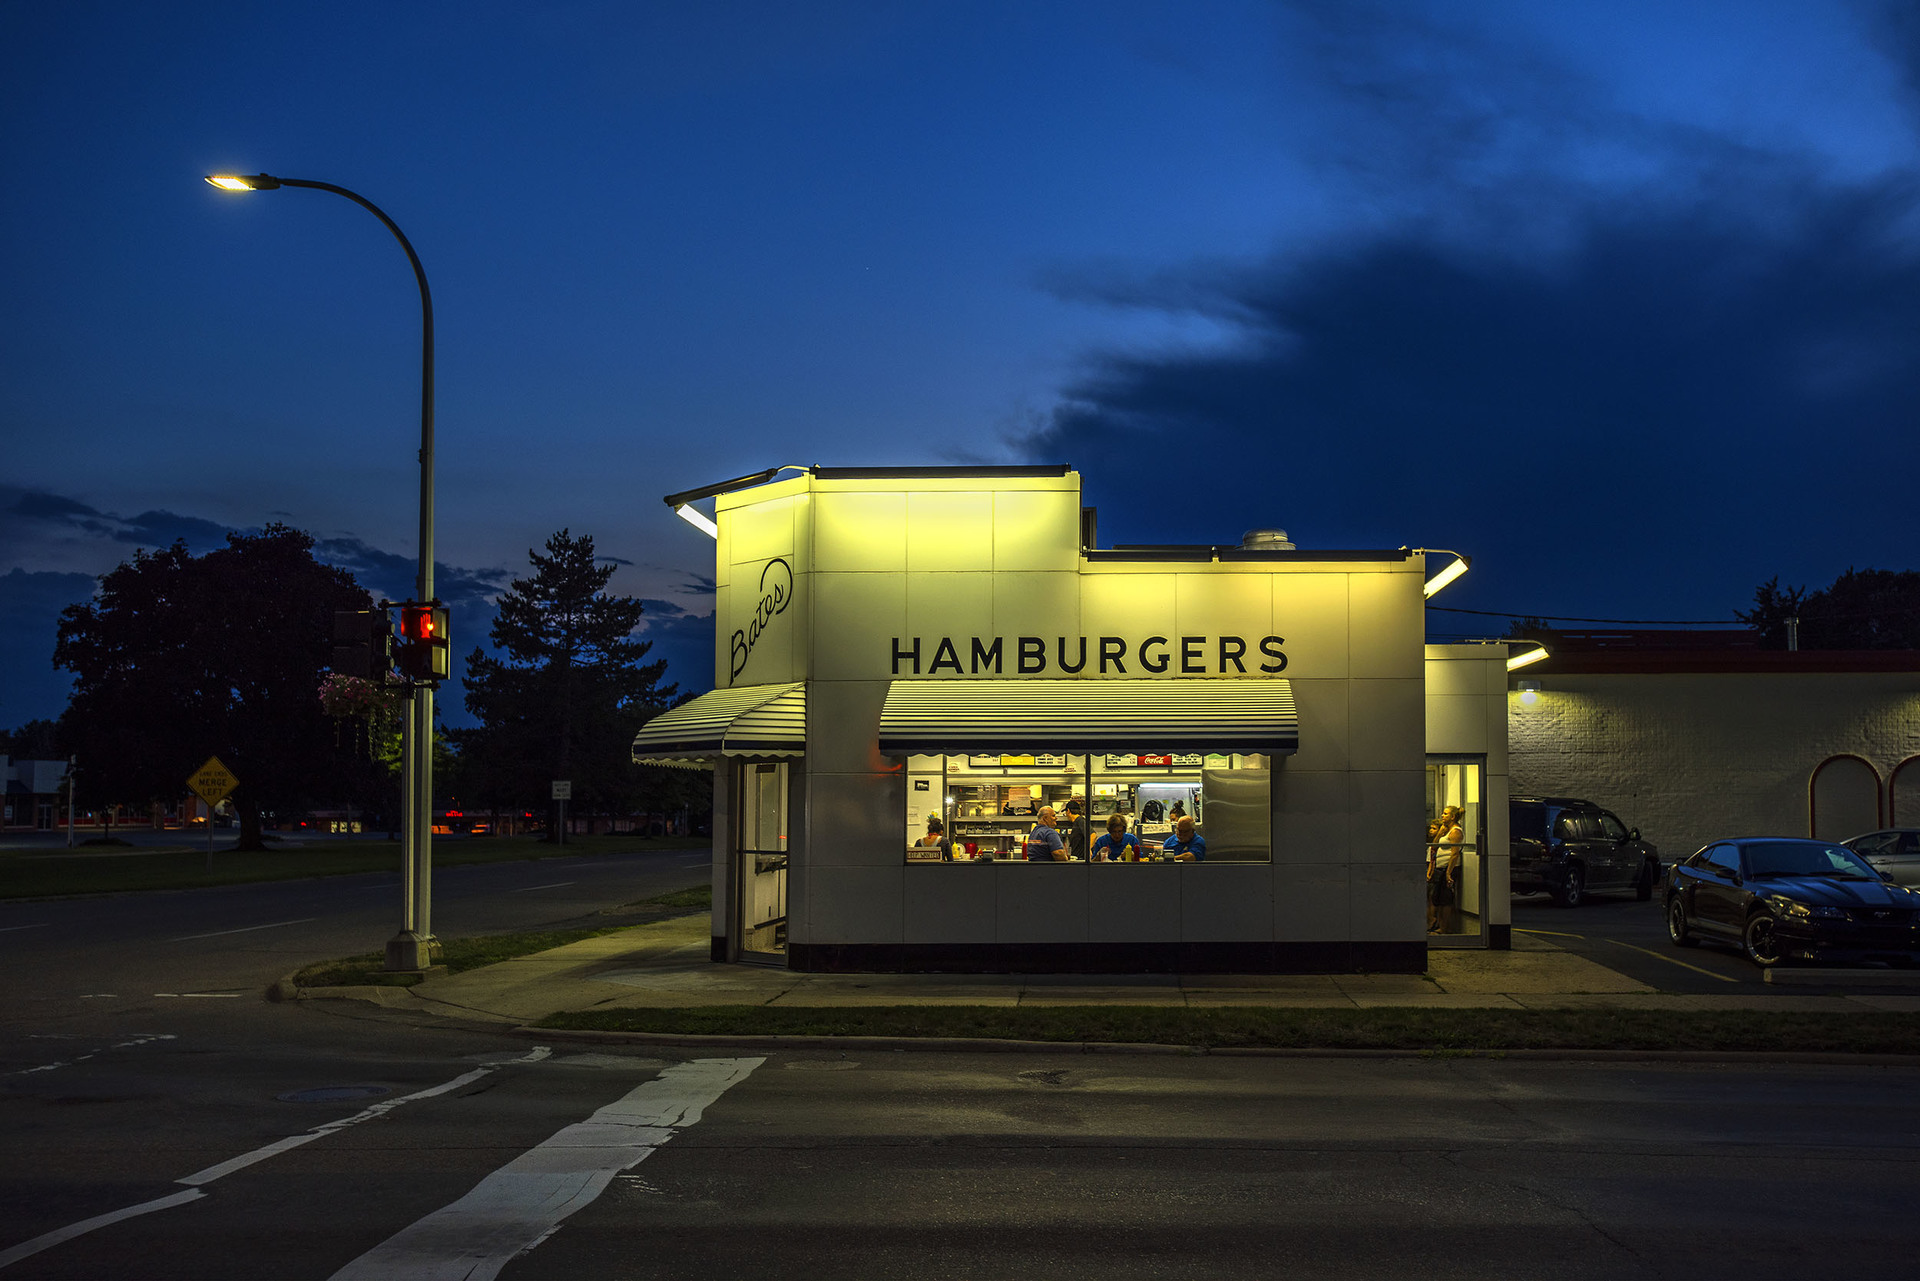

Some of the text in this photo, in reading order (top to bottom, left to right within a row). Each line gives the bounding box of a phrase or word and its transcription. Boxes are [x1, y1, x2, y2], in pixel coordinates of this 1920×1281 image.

[729, 583, 784, 687] Bates
[891, 636, 1289, 674] HAMBURGERS
[198, 778, 227, 787] MERGE
[202, 788, 222, 796] LEFT
